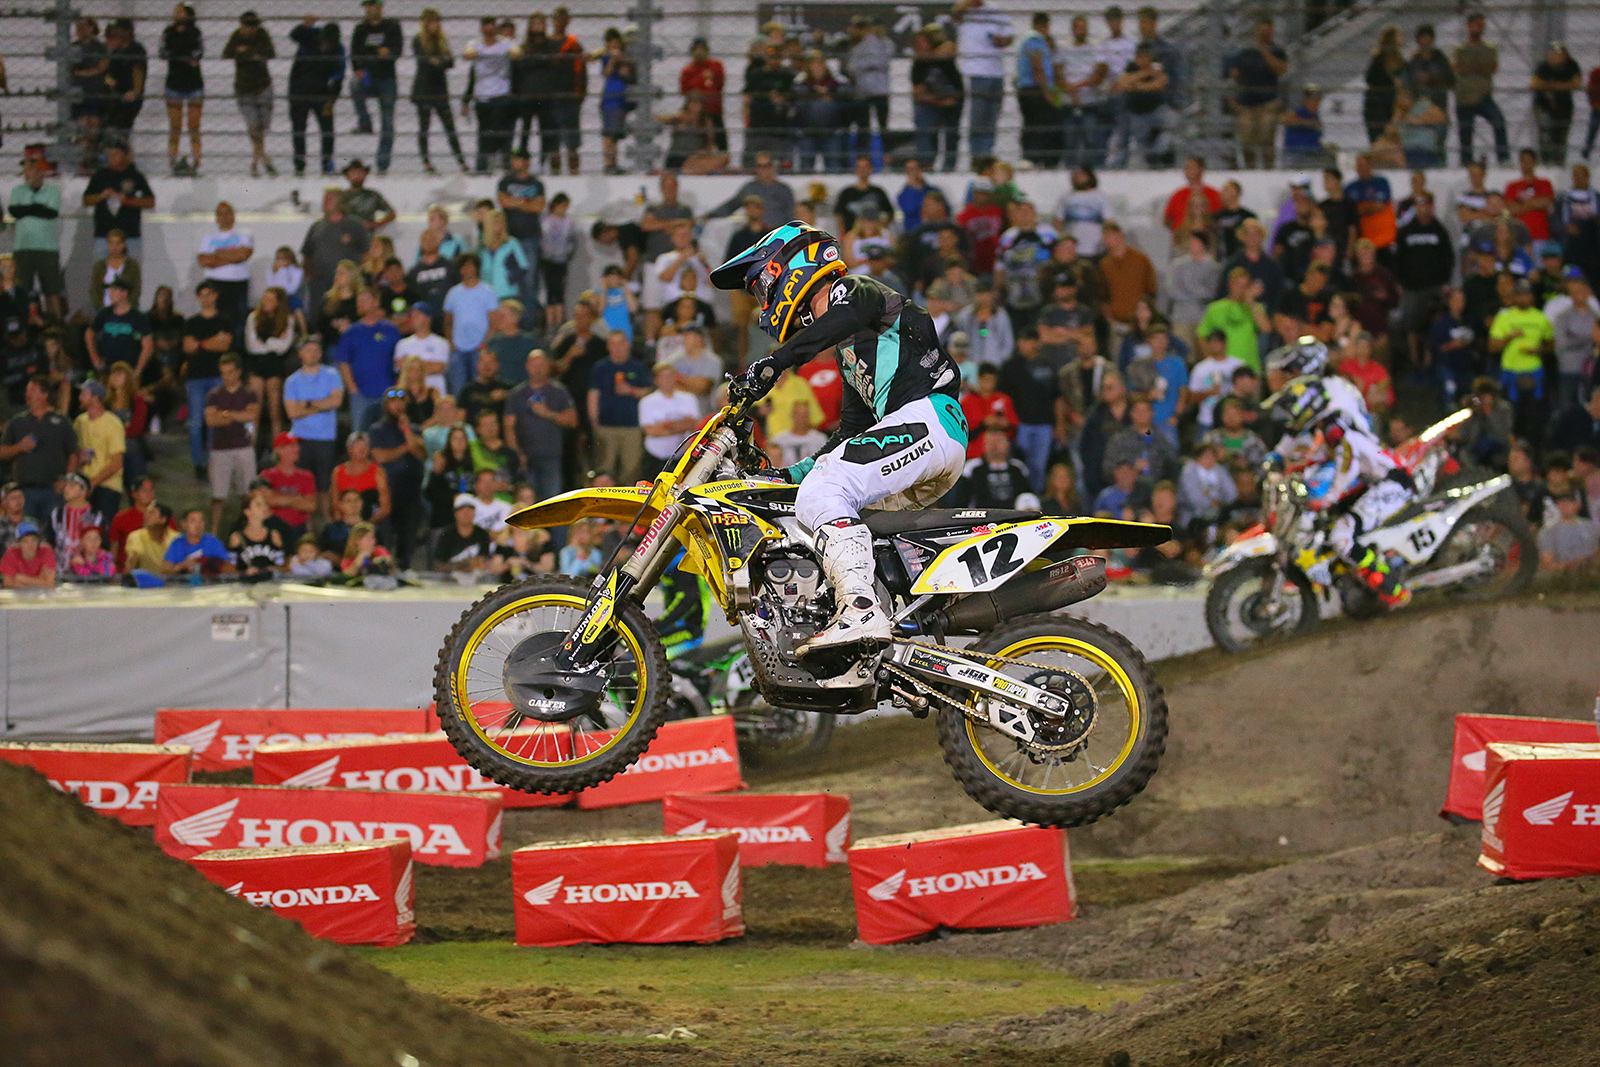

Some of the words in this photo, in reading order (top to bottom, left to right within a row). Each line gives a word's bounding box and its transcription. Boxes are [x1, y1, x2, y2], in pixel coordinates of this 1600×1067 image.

[880, 439, 934, 477] SUZUKI
[704, 482, 743, 494] Autotrader
[768, 502, 796, 513] SUZ
[635, 507, 673, 557] SHOWA
[1408, 527, 1436, 552] 15
[957, 533, 1025, 588] 12
[572, 597, 603, 641] DUNLOP
[910, 658, 929, 667] EXCEL
[958, 668, 990, 682] JGR
[450, 671, 467, 722] DUNLOP
[528, 699, 566, 709] GALFER
[238, 818, 471, 855] HONDA
[707, 826, 812, 844] ONDA
[907, 862, 1047, 897] HONDA
[243, 884, 380, 908] HONDA
[563, 880, 699, 904] HONDA
